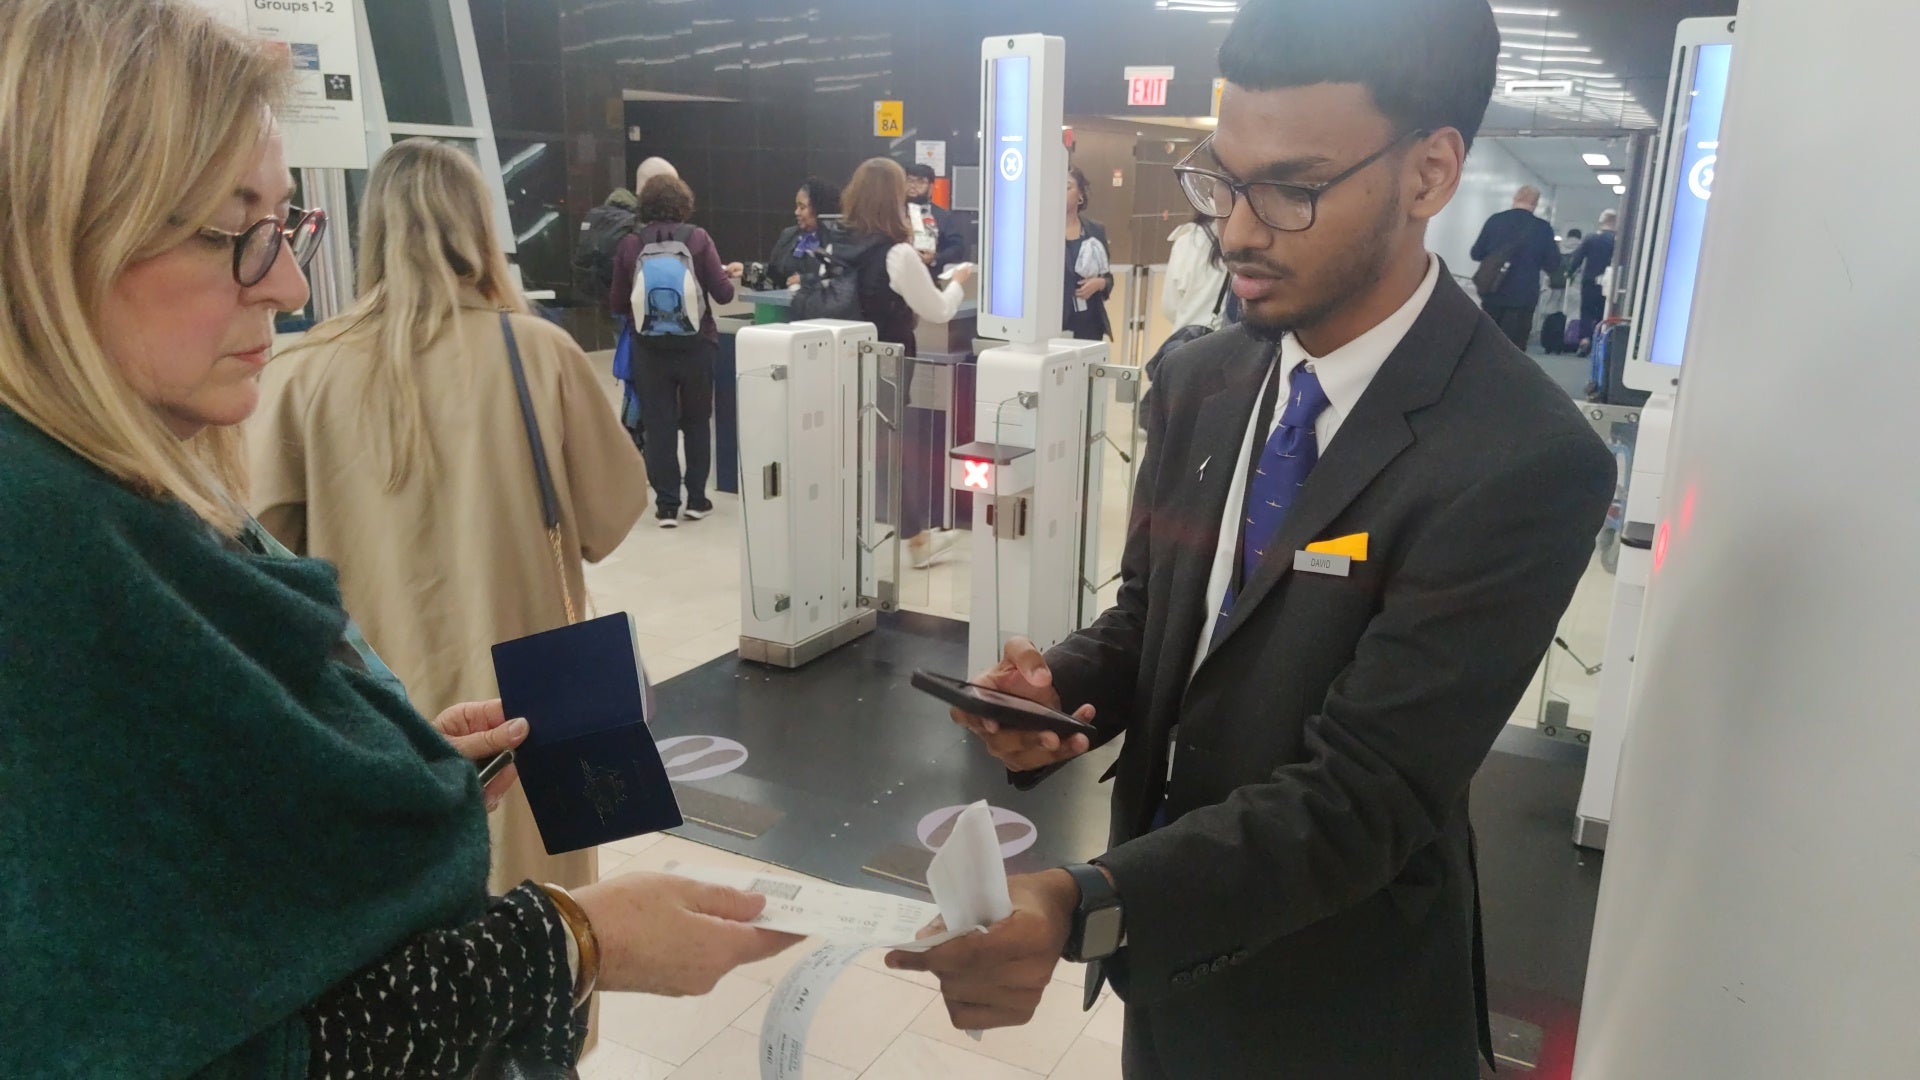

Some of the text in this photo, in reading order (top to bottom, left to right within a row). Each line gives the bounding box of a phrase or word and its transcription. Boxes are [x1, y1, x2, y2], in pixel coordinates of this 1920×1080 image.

[254, 0, 335, 13] Groups 1-2
[1132, 79, 1163, 104] EXIT
[882, 119, 898, 131] 8A
[1310, 558, 1331, 569] DAVID
[793, 987, 809, 1012] AKL
